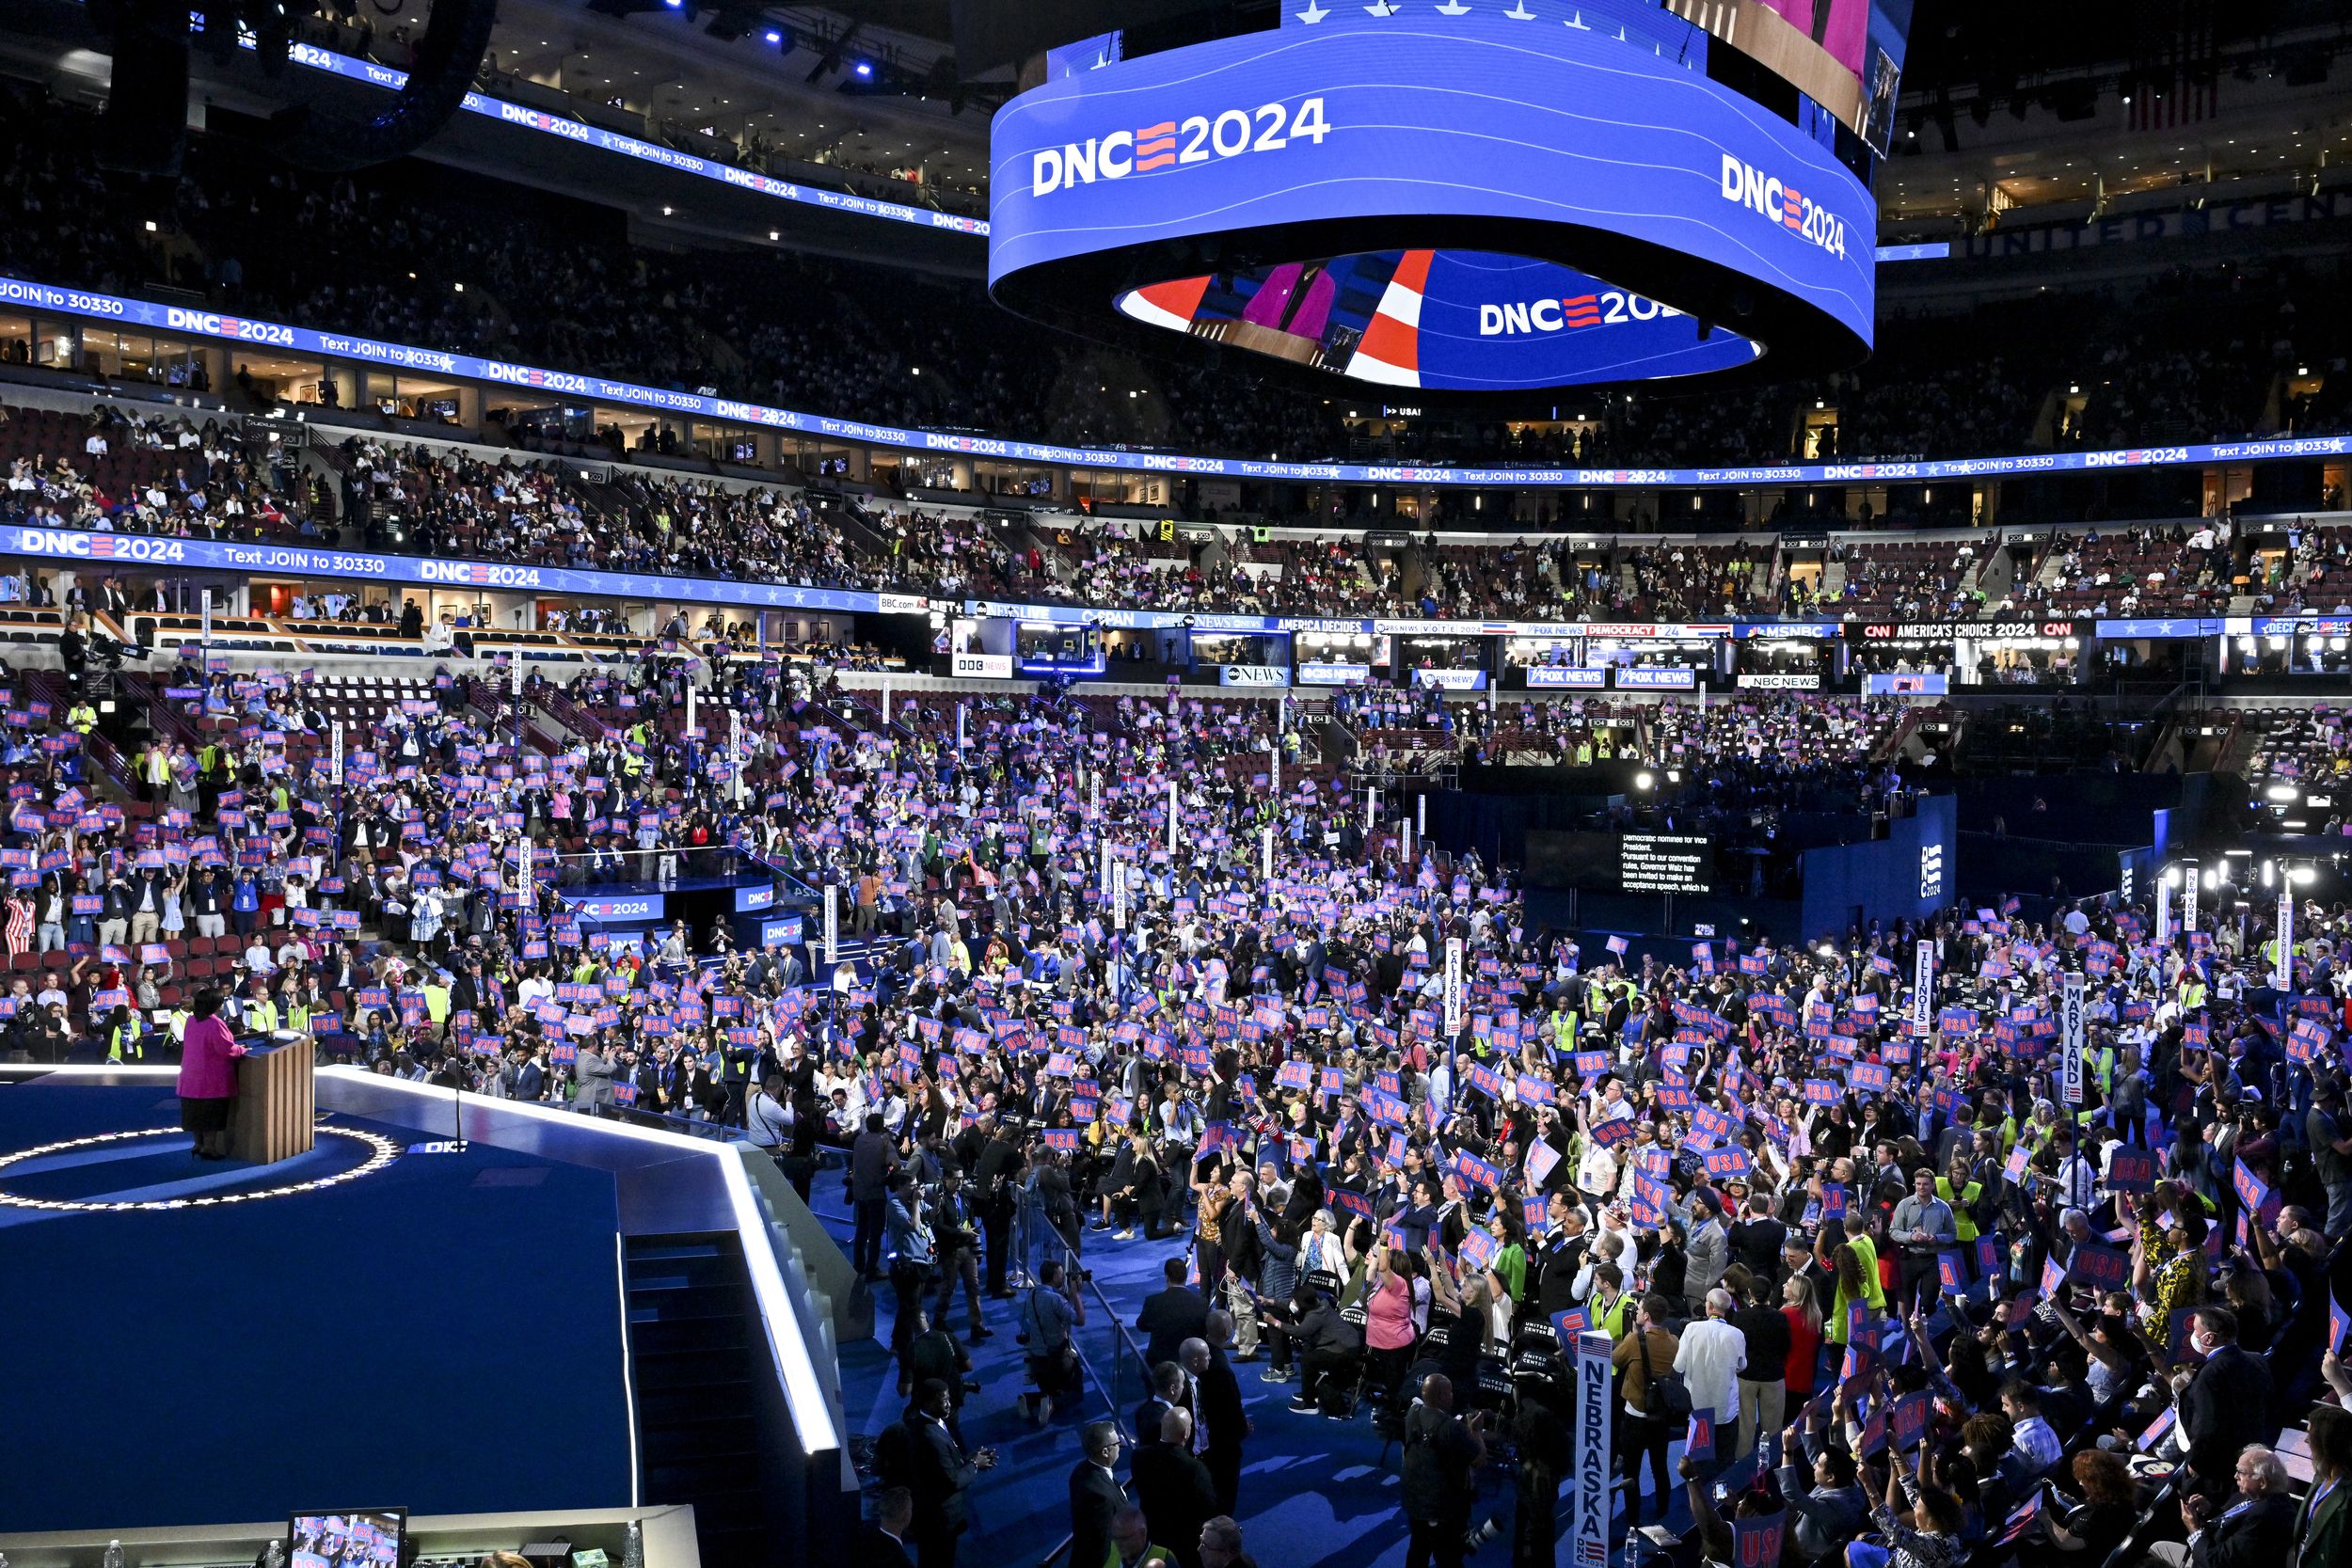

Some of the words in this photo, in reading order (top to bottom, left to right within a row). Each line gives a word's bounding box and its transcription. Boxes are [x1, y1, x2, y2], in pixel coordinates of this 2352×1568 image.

[613, 136, 633, 152] Text
[636, 143, 660, 160] JOIN
[661, 151, 671, 163] to
[673, 154, 704, 171] 30330
[0, 284, 41, 303] JOIN
[46, 289, 64, 305] to
[68, 293, 123, 315] 30330
[600, 383, 623, 396] Text
[626, 387, 652, 402] JOIN
[655, 392, 665, 403] to
[668, 393, 701, 409] 30330
[1464, 471, 1485, 481] Text
[1487, 471, 1513, 483] JOIN
[1516, 471, 1527, 482] to
[1529, 471, 1563, 482] 30330
[225, 547, 262, 563] Text
[265, 552, 308, 567] JOIN
[313, 555, 329, 569] to
[332, 557, 385, 573] 30330
[882, 599, 914, 609] BBC.com
[1196, 616, 1231, 628] NEWS
[1278, 619, 1320, 632] AMERICA
[1322, 621, 1361, 633] DECIDES
[1534, 626, 1552, 635] FOX
[1554, 626, 1583, 635] NEWS
[1589, 626, 1653, 636] DEMOCRACY
[1767, 626, 1822, 638] MSNBC
[1865, 626, 1890, 637] CNN
[1897, 624, 1952, 638] AMERICA'S
[1955, 624, 1992, 637] CHOICE
[2043, 624, 2071, 636] CNN
[960, 660, 983, 671] BBC
[986, 661, 1006, 671] NEWS
[1241, 668, 1284, 681] NEWS
[1311, 669, 1331, 679] CBS
[1334, 669, 1366, 680] NEWS
[1567, 671, 1601, 682] NEWS
[1658, 672, 1691, 683] NEWS
[1754, 677, 1779, 687] NBC
[1781, 677, 1819, 687] NEWS
[1623, 843, 1651, 851] President.
[1623, 862, 1639, 870] rules,
[1641, 863, 1667, 871] Governor
[12, 871, 40, 885] USA
[1116, 870, 1124, 919] DELAWARE
[1701, 884, 1708, 893] he
[1927, 884, 1940, 896] 2024
[74, 897, 101, 911] USA
[1742, 958, 1766, 972] USA
[1918, 952, 1928, 1022] ILLINOIS
[362, 990, 388, 1006] USA
[715, 999, 739, 1014] USA
[2299, 999, 2328, 1014] USA
[314, 1018, 339, 1032] USA
[644, 1018, 670, 1033] USA
[2067, 988, 2080, 1085] MARYLAND
[1579, 1056, 1605, 1070] USA
[1852, 1066, 1883, 1085] USA
[1595, 1123, 1631, 1143] USA
[1045, 1133, 1074, 1148] USA
[1708, 1153, 1744, 1172] USA
[1458, 1157, 1498, 1185] USA
[2113, 1158, 2151, 1182] USA
[2235, 1165, 2259, 1203] USA
[2077, 1249, 2122, 1280] USA
[1525, 1322, 1547, 1330] UNITED
[1581, 1360, 1604, 1539] NEBRASKA
